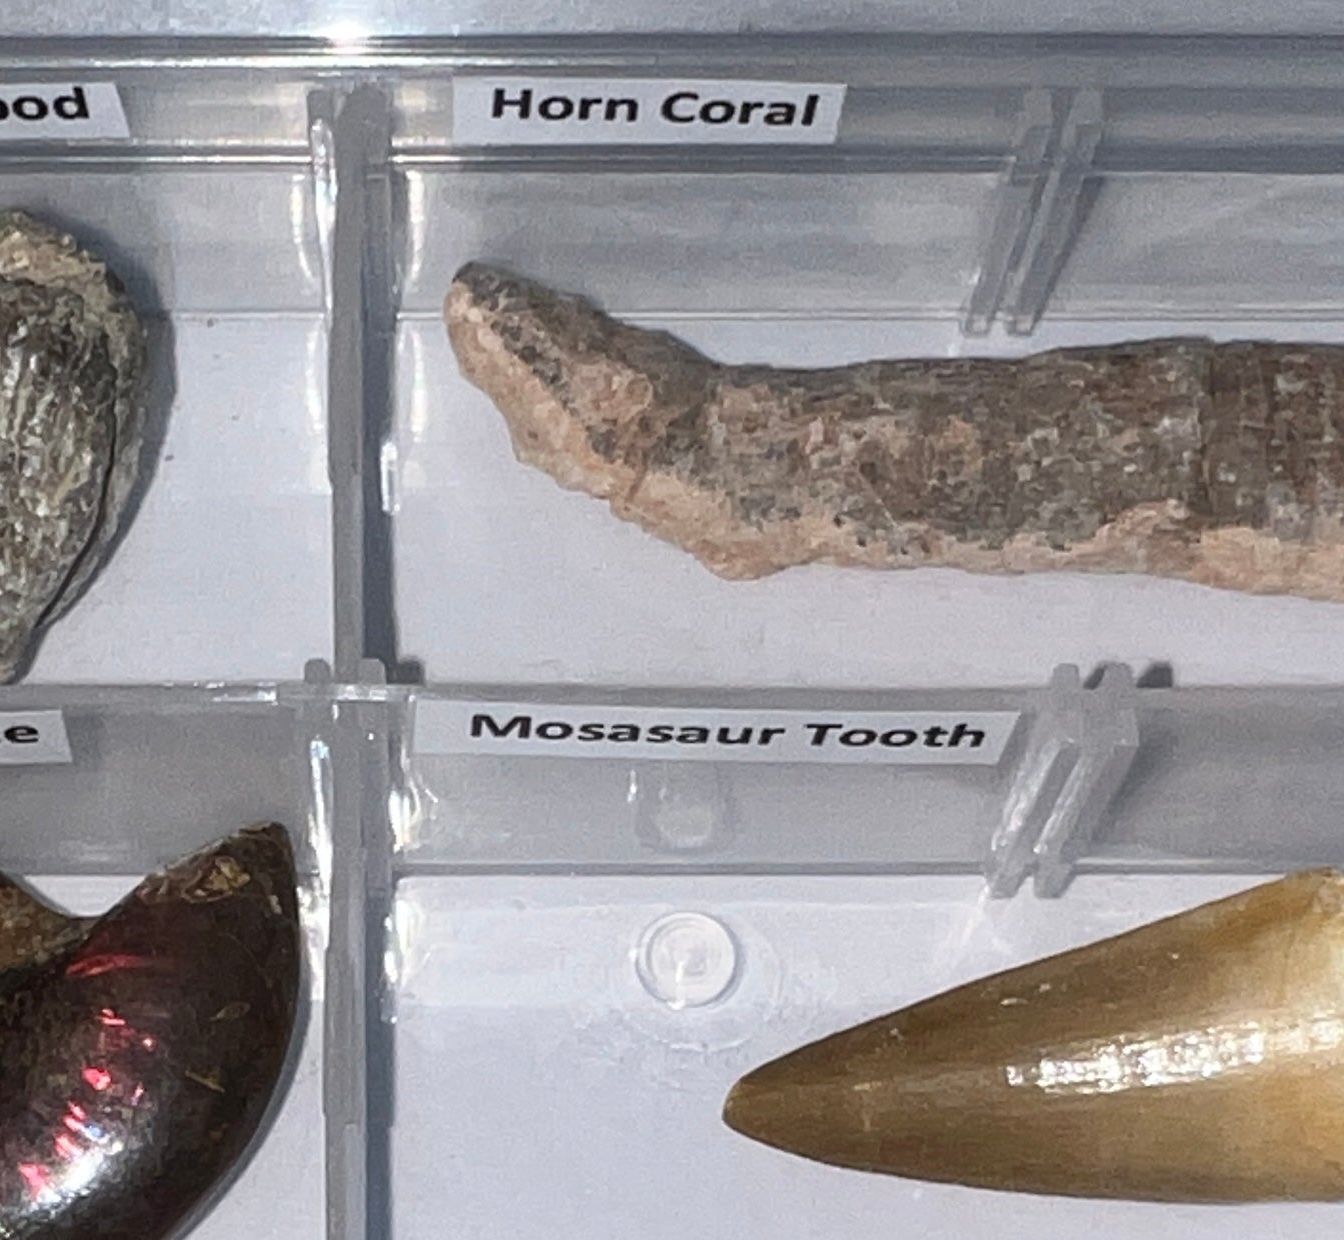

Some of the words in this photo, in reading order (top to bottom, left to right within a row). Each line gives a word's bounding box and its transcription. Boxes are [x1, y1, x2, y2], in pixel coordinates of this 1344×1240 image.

[491, 88, 639, 123] Horn
[661, 91, 820, 127] Coral
[470, 713, 786, 747] Mosasaur
[803, 721, 986, 749] Tooth
